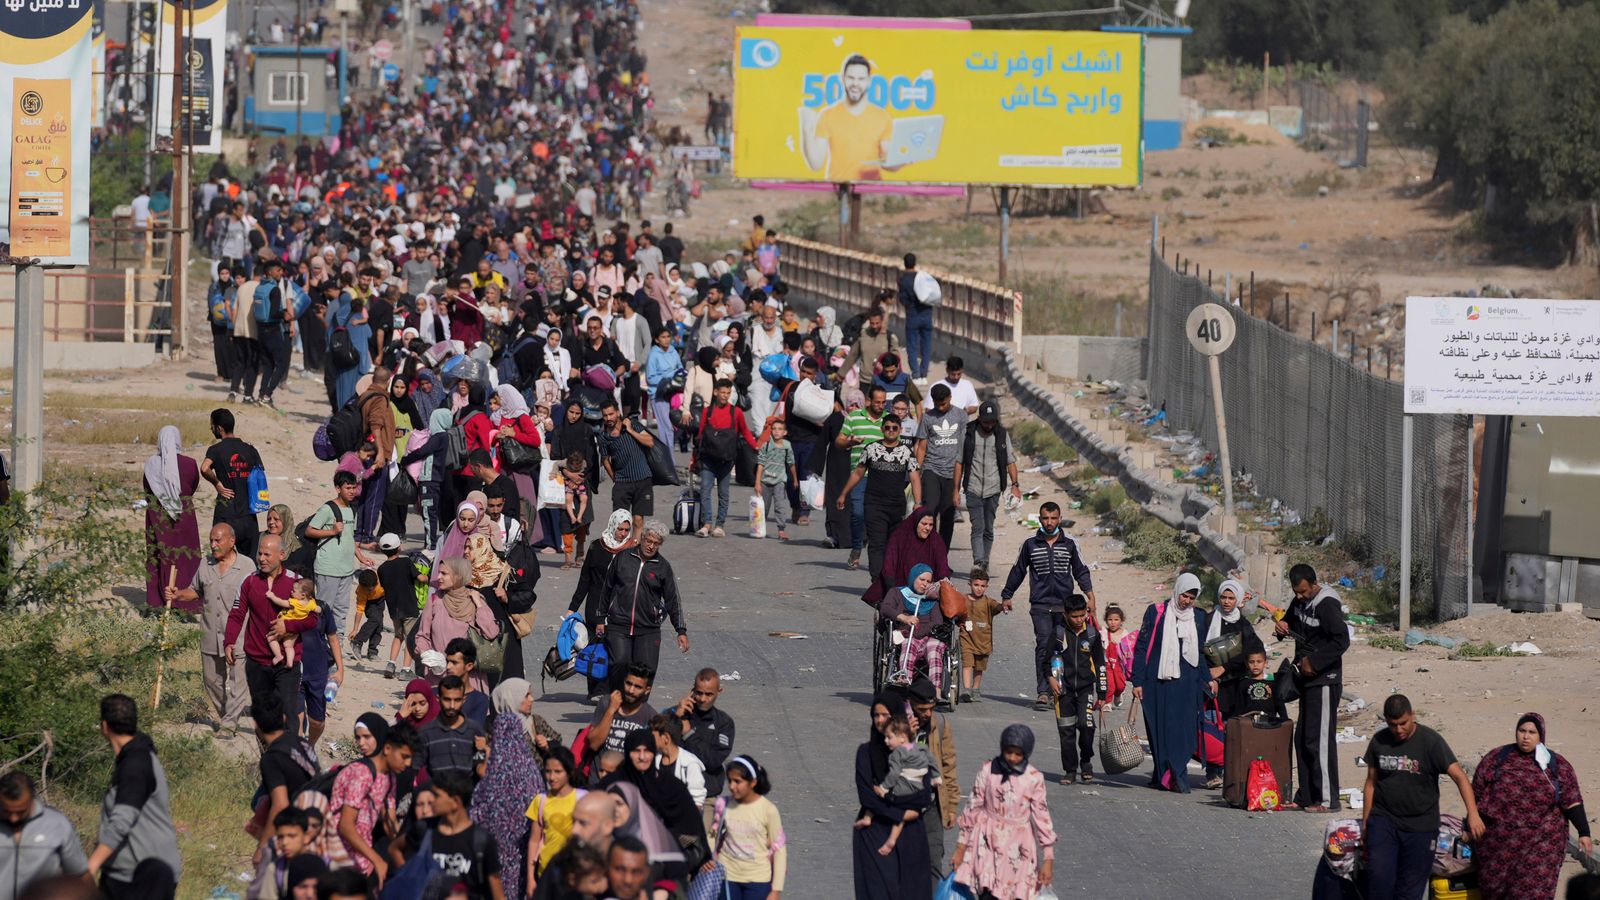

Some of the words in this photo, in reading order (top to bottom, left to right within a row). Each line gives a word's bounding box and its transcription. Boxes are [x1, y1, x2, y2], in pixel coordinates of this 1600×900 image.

[965, 51, 998, 71] نت
[1003, 45, 1053, 78] أوفر
[1061, 49, 1121, 78] اشبك
[1001, 83, 1058, 111] كاش
[1066, 86, 1121, 114] واربح
[15, 135, 51, 144] GALAG
[1488, 306, 1518, 316] Belgium
[1197, 318, 1221, 343] 40
[1443, 330, 1479, 343] والطيور
[1483, 331, 1518, 344] للنباتات
[1522, 331, 1550, 345] موطن
[1554, 332, 1571, 345] غزة
[1439, 346, 1469, 357] نظافته
[1471, 348, 1499, 361] وعلى
[1501, 348, 1522, 360] عليه
[1525, 347, 1562, 360] فلنحافظ
[1566, 348, 1600, 362] لجميلة،
[935, 438, 958, 446] adidas
[611, 719, 643, 731] LLISTE
